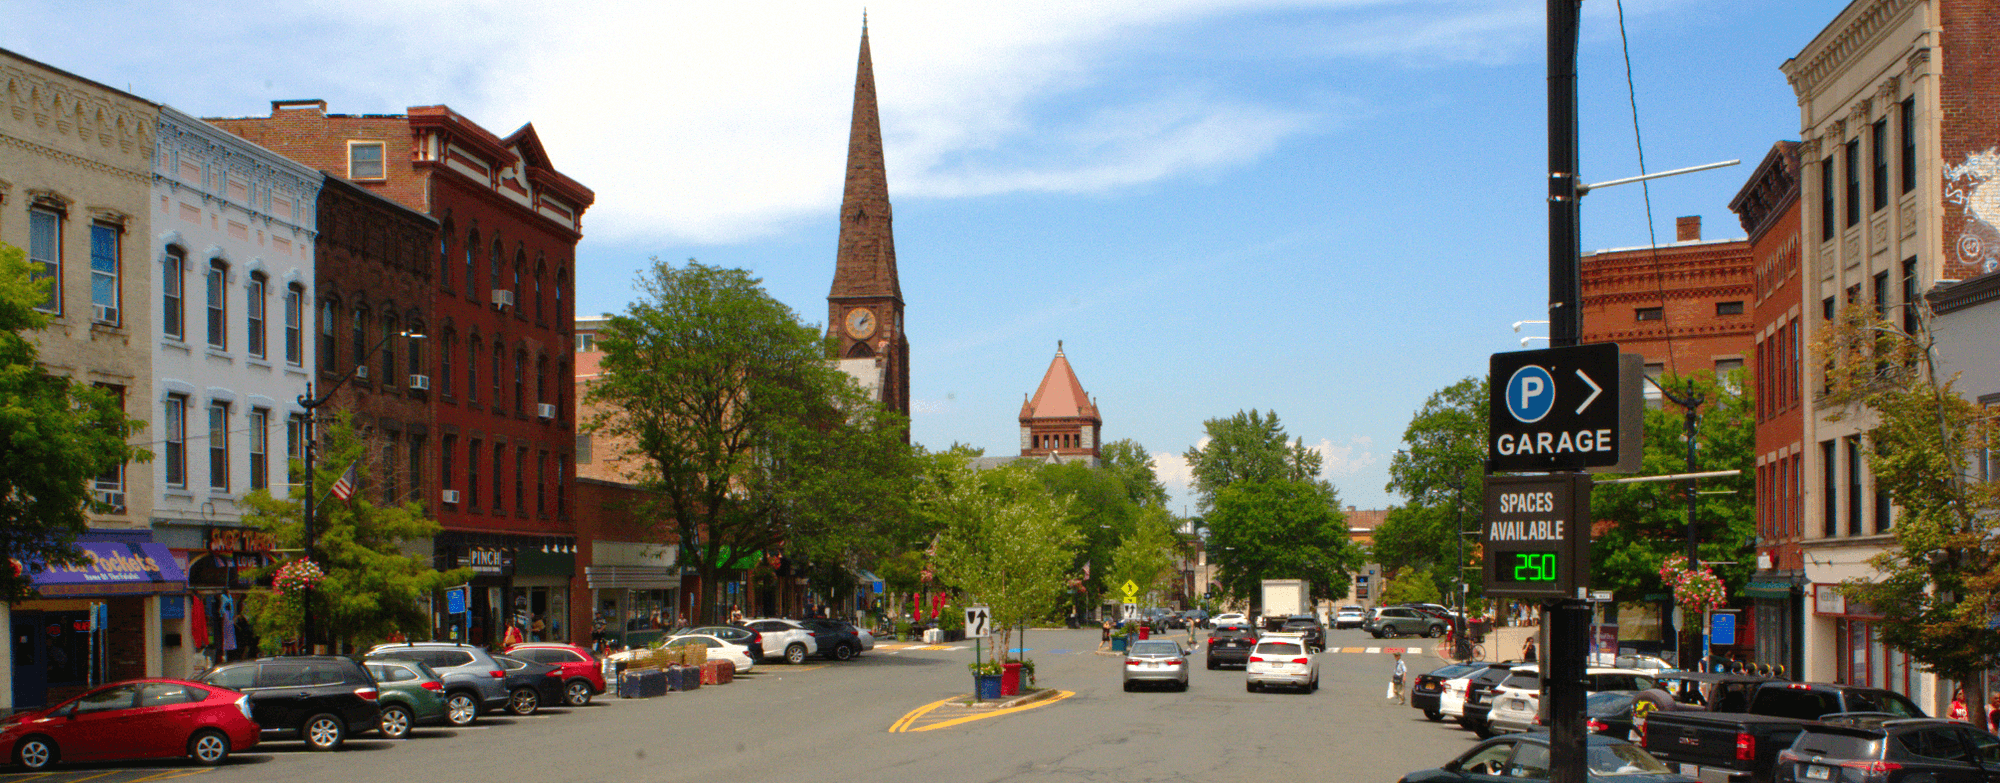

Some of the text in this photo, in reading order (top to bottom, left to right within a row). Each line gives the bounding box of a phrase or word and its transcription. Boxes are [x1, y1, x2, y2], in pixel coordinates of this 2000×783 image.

[1521, 376, 1544, 409] P
[1497, 429, 1612, 456] GARAGE
[1500, 492, 1554, 514] SPACES
[1489, 520, 1564, 541] AVAILABLE
[84, 549, 160, 573] Pockets
[237, 555, 257, 568] LOVE
[471, 550, 500, 566] PINCH
[1515, 554, 1555, 580] 250
